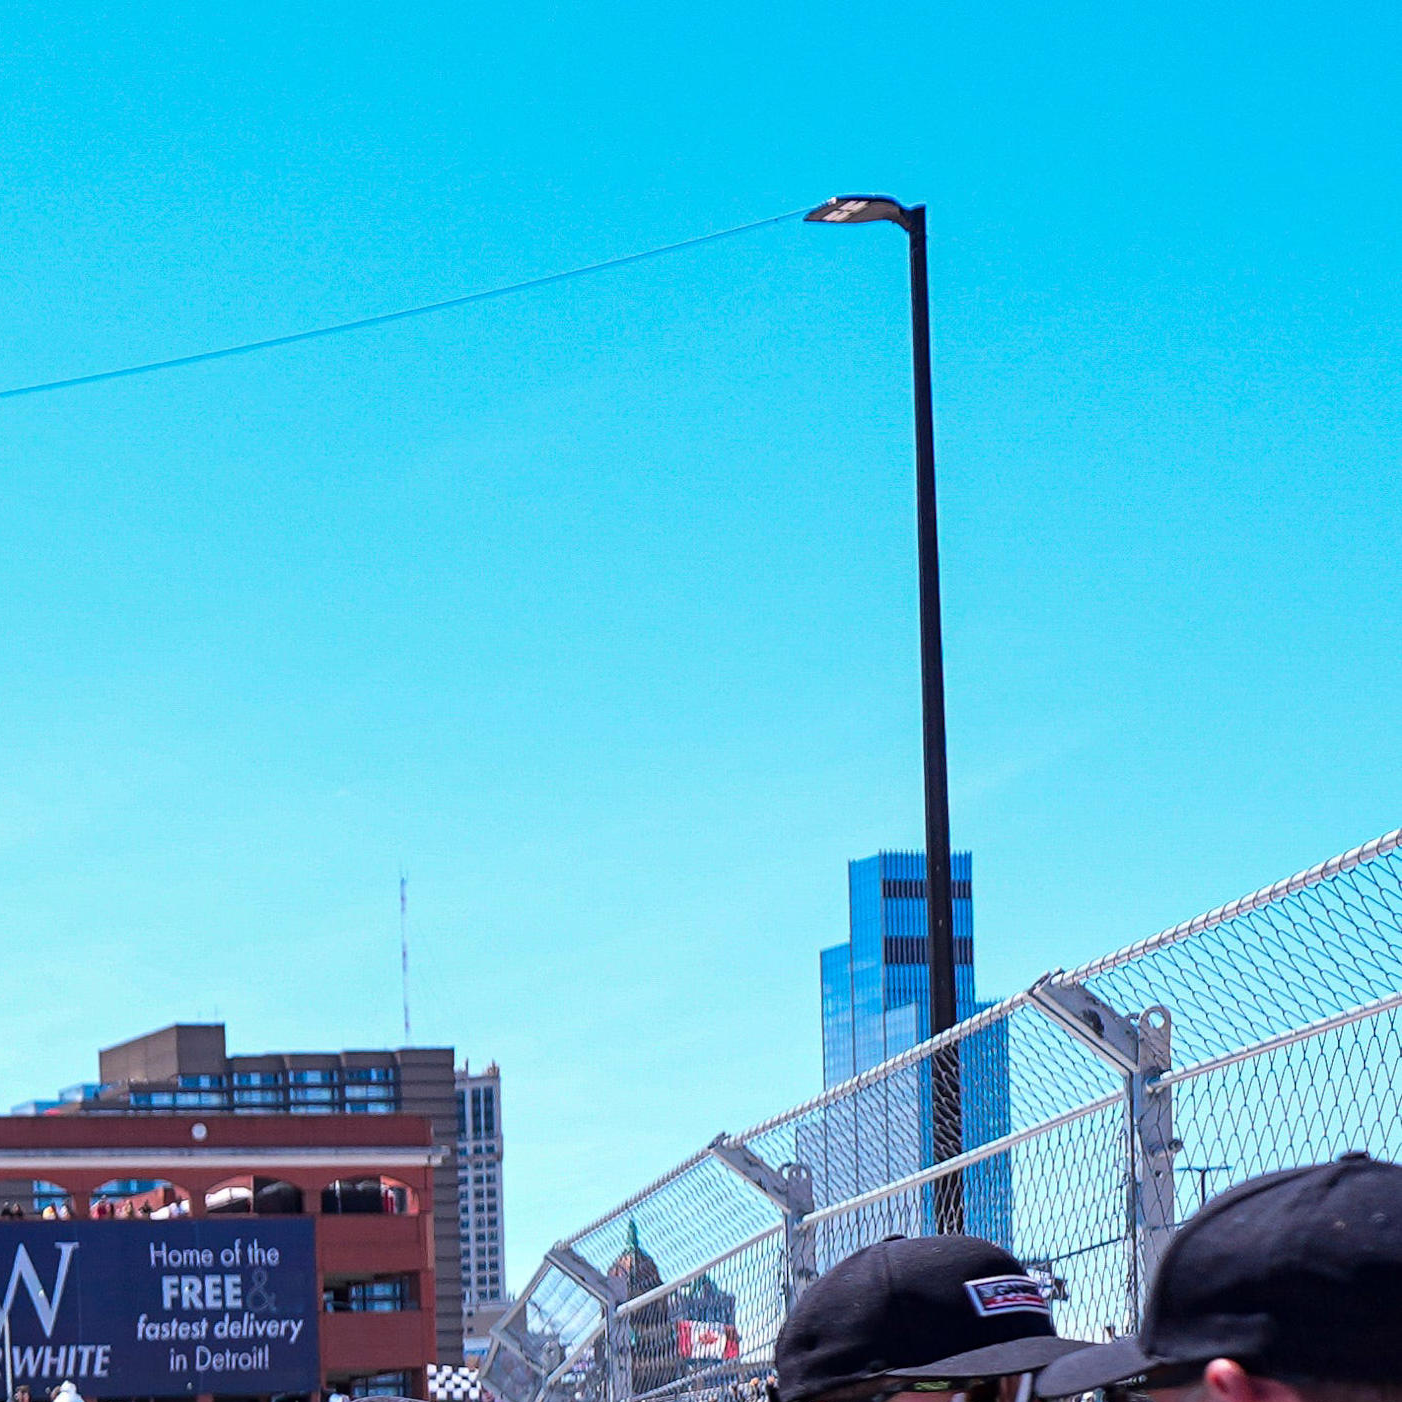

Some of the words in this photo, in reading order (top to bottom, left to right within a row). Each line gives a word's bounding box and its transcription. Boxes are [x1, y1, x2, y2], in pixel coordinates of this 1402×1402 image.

[150, 1241, 214, 1268] Home
[220, 1238, 242, 1267] of
[247, 1238, 280, 1267] the
[161, 1274, 243, 1310] FREE
[137, 1313, 209, 1341] fastest
[213, 1311, 304, 1344] delivery
[169, 1347, 187, 1372] in
[195, 1343, 270, 1373] Detroit!
